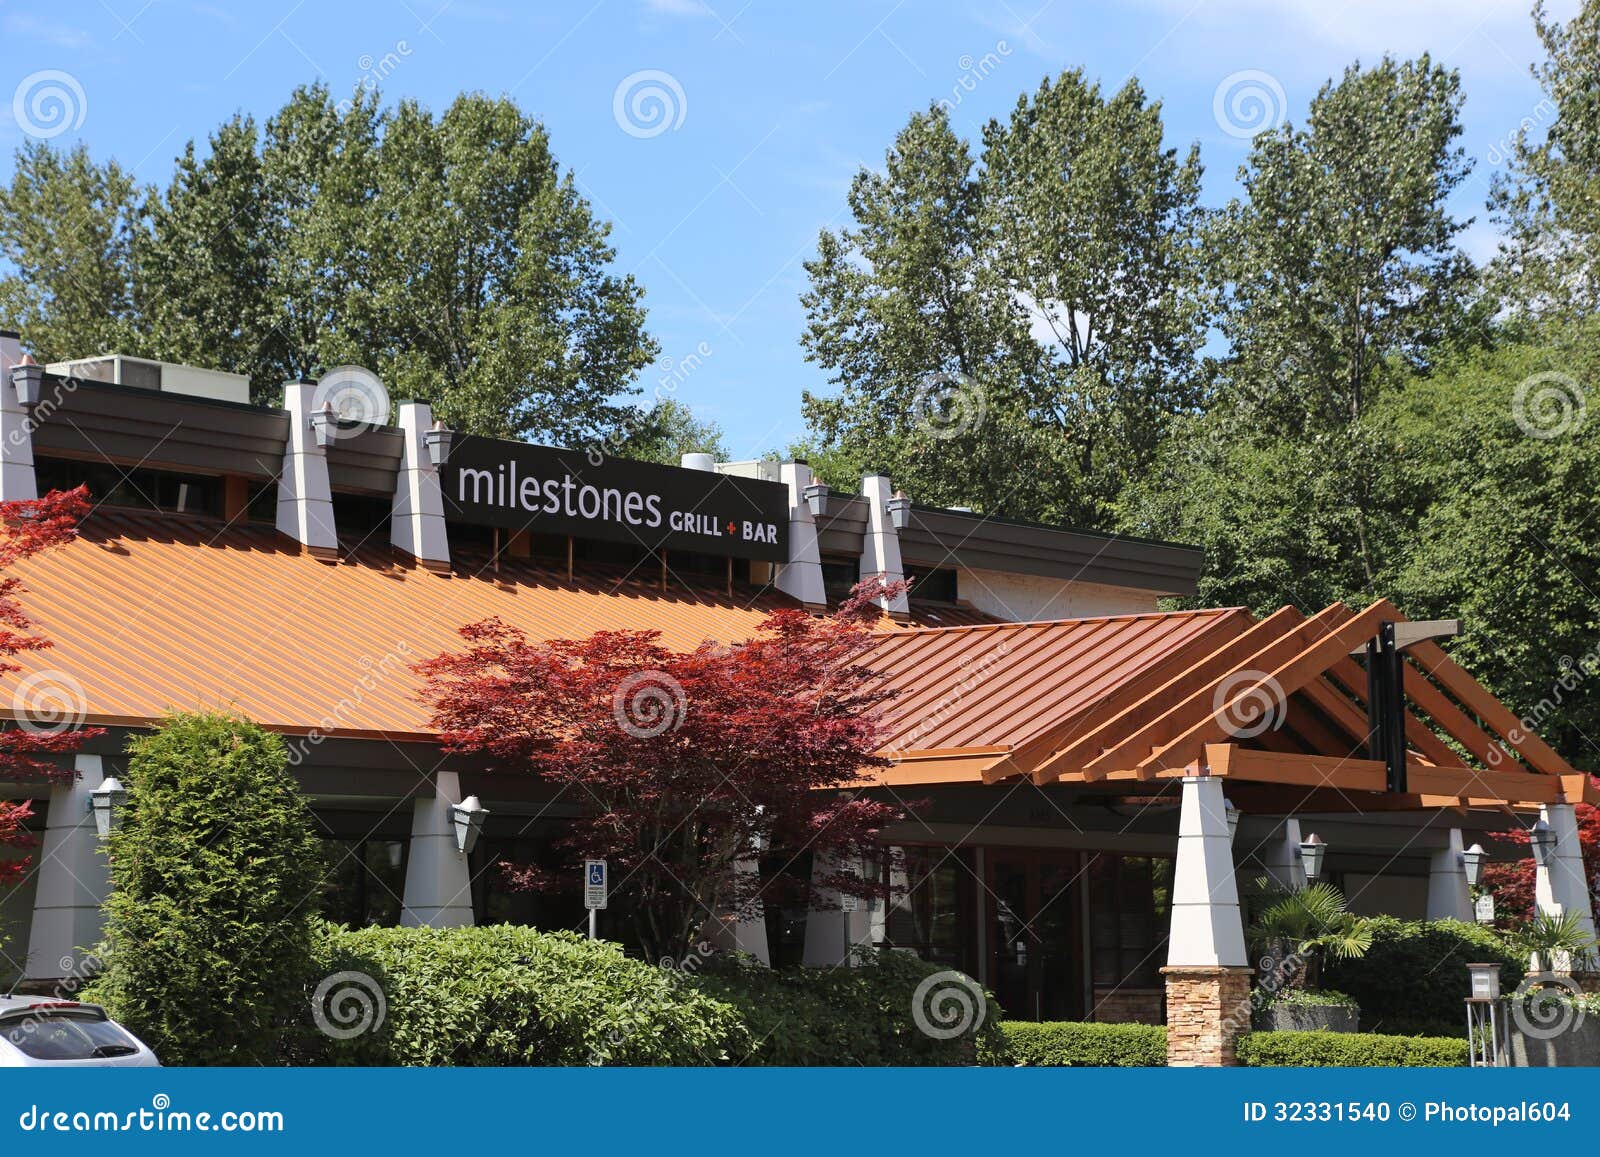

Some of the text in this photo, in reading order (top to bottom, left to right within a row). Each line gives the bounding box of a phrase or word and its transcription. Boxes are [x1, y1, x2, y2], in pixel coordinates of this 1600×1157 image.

[458, 460, 662, 527] milestones
[669, 510, 722, 537] GRILL
[742, 520, 778, 545] BAR
